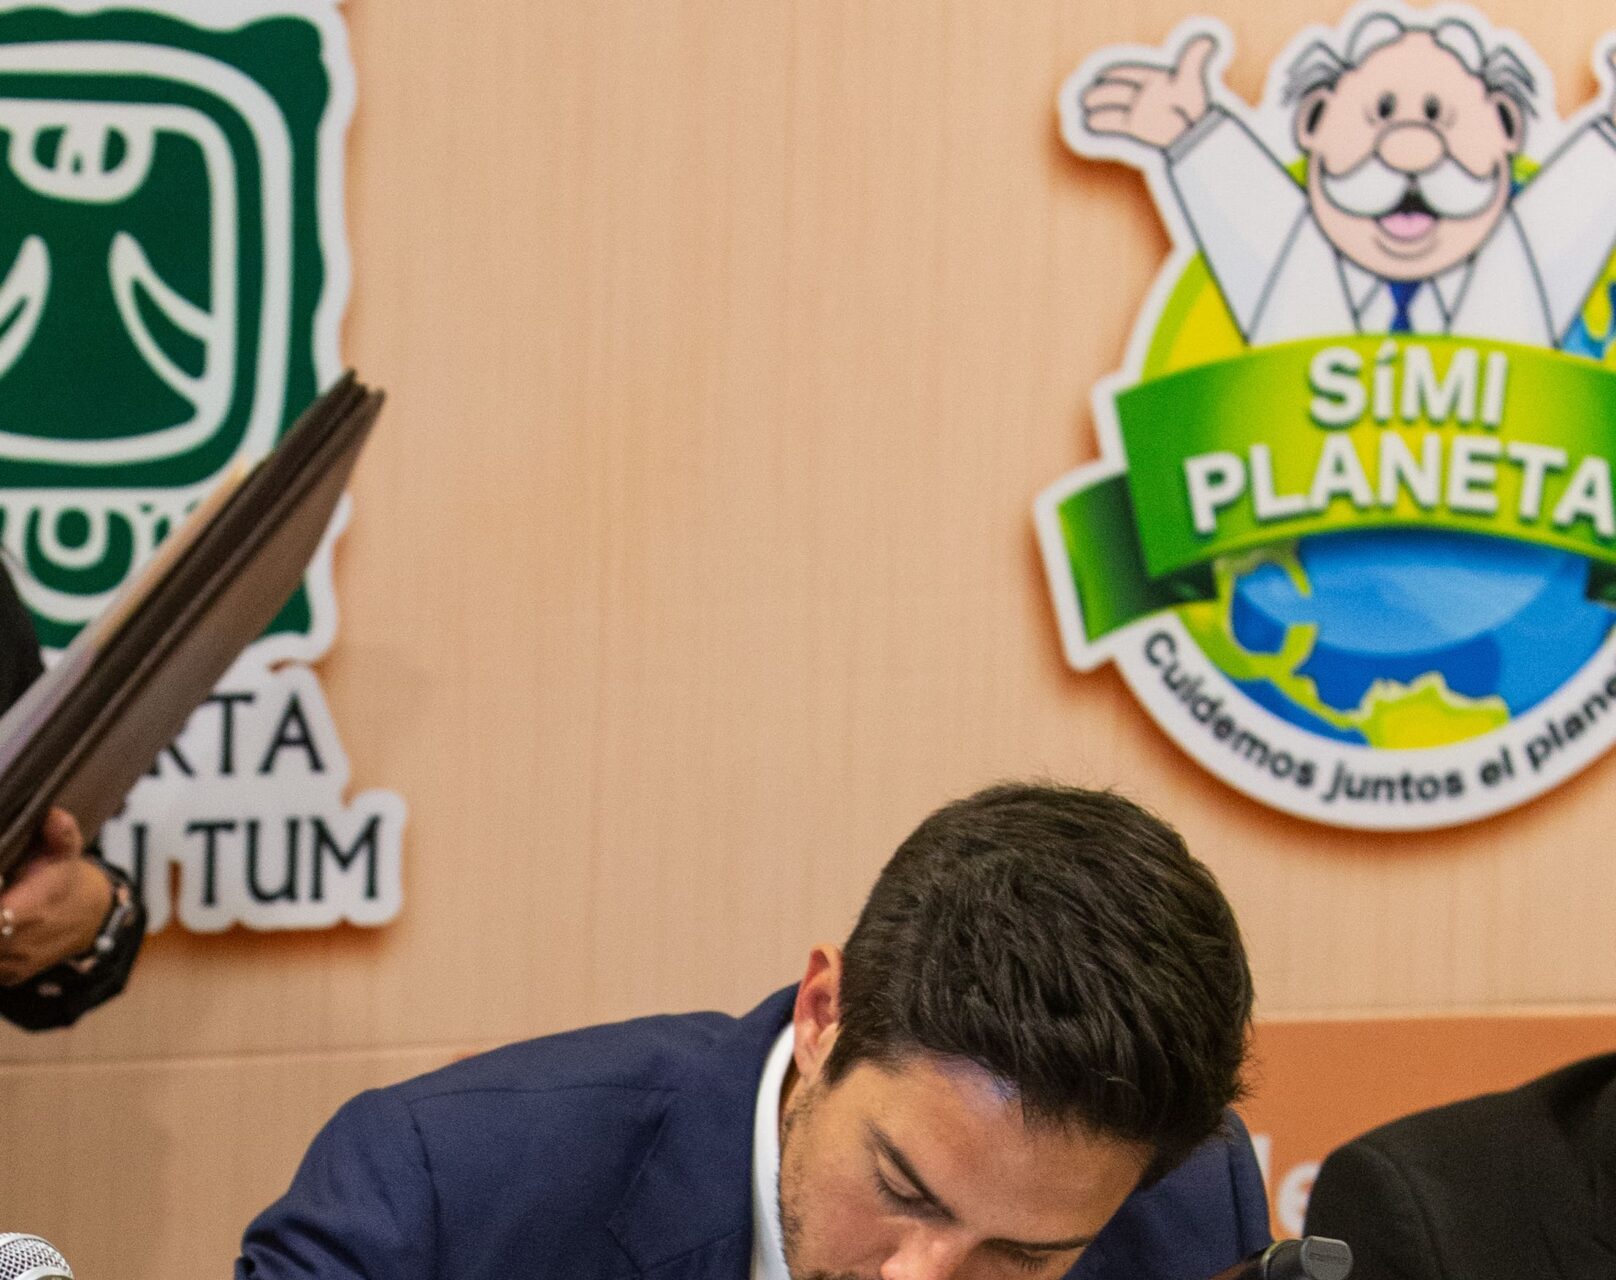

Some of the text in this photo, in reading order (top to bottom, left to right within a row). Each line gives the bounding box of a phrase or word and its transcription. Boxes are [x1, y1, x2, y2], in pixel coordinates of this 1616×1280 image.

[1184, 432, 1616, 536] PLANETA
[1144, 631, 1316, 788] Cuidemos
[1320, 759, 1465, 803] juntos
[1479, 746, 1514, 786] el
[185, 814, 381, 906] TUM
